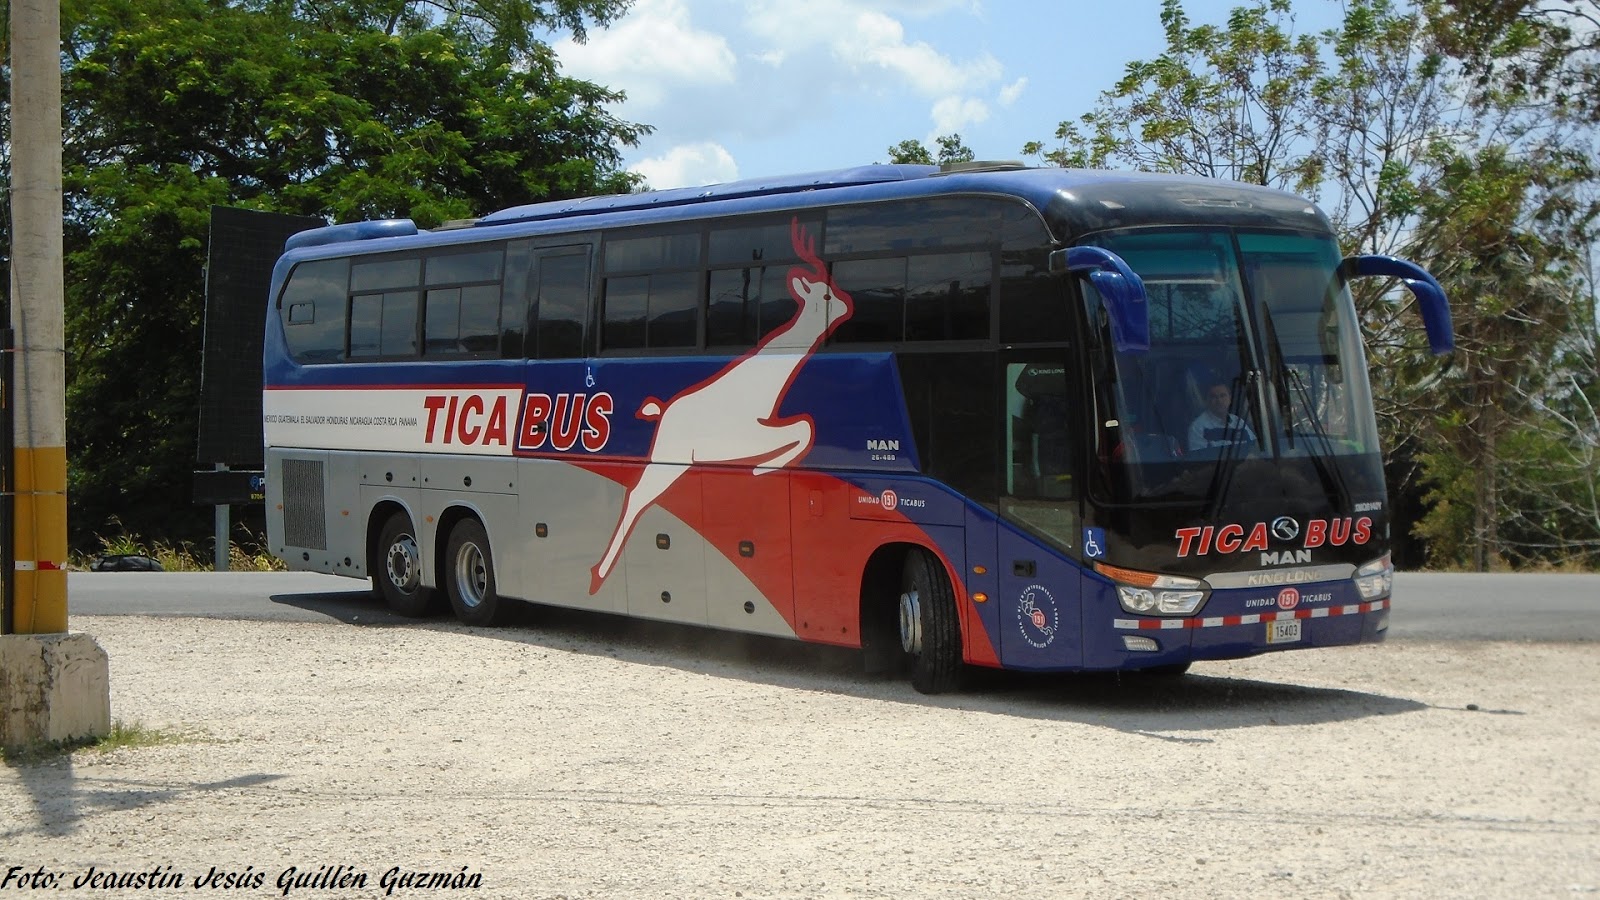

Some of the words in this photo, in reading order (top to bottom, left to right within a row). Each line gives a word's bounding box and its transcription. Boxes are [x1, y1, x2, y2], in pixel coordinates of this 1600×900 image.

[278, 415, 299, 424] GUATEMALA
[300, 416, 305, 424] EL
[305, 416, 325, 424] SALVADOR
[326, 416, 348, 425] HONDURAS
[349, 416, 372, 426] NICARAGUA
[373, 416, 387, 426] COSTA
[388, 417, 398, 426] RICA
[399, 417, 418, 426] PANAMA
[424, 395, 507, 446] TICA
[519, 392, 614, 452] BUS
[867, 440, 899, 451] MAN
[858, 496, 880, 504] UNIDAD
[883, 494, 894, 506] 151
[900, 498, 926, 508] TICABUS
[1175, 522, 1269, 558] TICA
[1304, 517, 1373, 549] BUS
[1261, 549, 1312, 567] MAN
[1248, 572, 1285, 586] KING
[1246, 598, 1275, 608] UNIDAD
[1281, 593, 1296, 605] 151
[1301, 593, 1332, 603] TICABUS
[1034, 615, 1044, 624] 151
[1275, 624, 1298, 638] 15403
